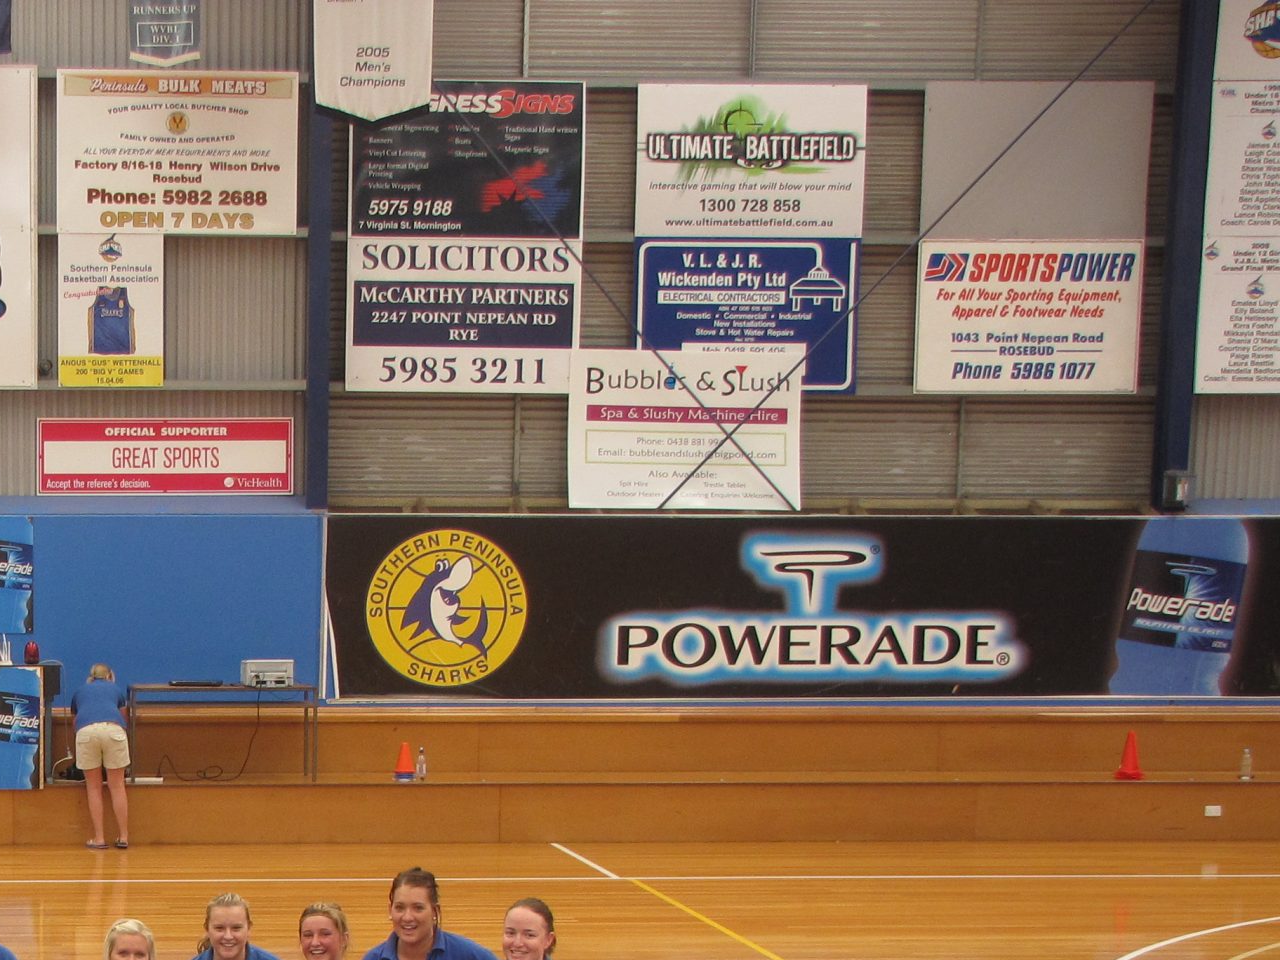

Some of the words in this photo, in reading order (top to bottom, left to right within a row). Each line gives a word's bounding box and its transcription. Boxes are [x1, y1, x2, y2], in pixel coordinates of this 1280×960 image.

[356, 47, 390, 58] 2005
[355, 61, 390, 72] Men's
[90, 79, 148, 93] Peninsula
[158, 79, 200, 93] BULK
[212, 80, 266, 94] MEATS
[340, 76, 405, 88] Champions
[648, 135, 733, 159] ULTIMATE
[746, 136, 854, 159] BATTLEFIELD
[75, 161, 117, 171] Factory
[121, 161, 162, 170] 8/16-18
[169, 161, 202, 173] Henry
[210, 162, 247, 171] Wilson
[251, 163, 280, 172] Drive
[153, 174, 201, 183] Rosebud
[649, 182, 698, 191] Interactive
[701, 182, 735, 192] gaming
[738, 182, 757, 191] that
[760, 182, 776, 191] will
[779, 182, 802, 191] blow
[805, 184, 825, 192] your
[827, 182, 852, 191] mind
[87, 189, 155, 205] Phone:
[163, 190, 212, 205] 5982
[218, 191, 267, 206] 2688
[369, 200, 408, 215] 5975
[413, 200, 452, 216] 9188
[700, 199, 735, 212] 1300
[742, 200, 767, 212] 728
[773, 200, 800, 212] 858
[100, 211, 163, 228] OPEN
[172, 212, 185, 228] 7
[192, 213, 254, 229] DAYS
[366, 222, 398, 230] Virginia
[400, 221, 411, 229] St.
[414, 222, 461, 231] Mornington
[665, 218, 833, 227] www.ultimatebattlefield.com.au
[362, 243, 570, 272] SOLICITORS
[970, 253, 1135, 282] SPORTSPOWER
[658, 272, 732, 287] Wickenden
[738, 273, 761, 289] Pty
[766, 273, 785, 287] Ltd
[360, 287, 466, 305] McCARTHY
[471, 288, 568, 306] PARTNERS
[663, 293, 713, 302] ELECTRICAL
[717, 293, 780, 302] CONTRACTORS
[937, 289, 955, 300] For
[959, 289, 974, 300] All
[977, 289, 1002, 301] Your
[1007, 289, 1053, 304] Sporting
[1058, 289, 1121, 303] Equipment,
[371, 312, 406, 323] 2247
[411, 312, 461, 324] POINT
[466, 313, 528, 325] NEPEAN
[532, 314, 556, 325] RD
[952, 305, 996, 320] Apparel
[1000, 306, 1009, 318] &
[1013, 305, 1066, 318] Footwear
[1070, 305, 1104, 318] Needs
[449, 330, 478, 341] RYE
[951, 333, 979, 343] 1043
[986, 333, 1018, 343] Point
[1022, 333, 1068, 344] Nepean
[1072, 333, 1103, 343] Road
[999, 346, 1054, 356] ROSEBUD
[379, 357, 457, 383] 5985
[470, 358, 545, 384] 3211
[952, 362, 1001, 380] Phone
[1010, 362, 1054, 379] 5986
[1060, 363, 1095, 379] 1077
[586, 367, 687, 394] Bubbles
[697, 371, 716, 391] &
[600, 408, 623, 418] Spa
[628, 408, 638, 418] &
[644, 408, 683, 421] Slushy
[105, 427, 155, 436] OFFICIAL
[161, 427, 227, 436] SUPPORTER
[112, 447, 156, 469] GREAT
[163, 447, 219, 468] SPORTS
[47, 479, 71, 490] Accept
[73, 479, 85, 488] the
[87, 479, 117, 488] referee's
[120, 479, 150, 488] decision.
[238, 478, 282, 488] VicHealth
[370, 534, 440, 617] SOUTHERN
[450, 533, 524, 616] PENINSULA
[1127, 588, 1235, 623] Powerade
[617, 623, 999, 668] POWERADE
[407, 659, 489, 683] SHARKS
